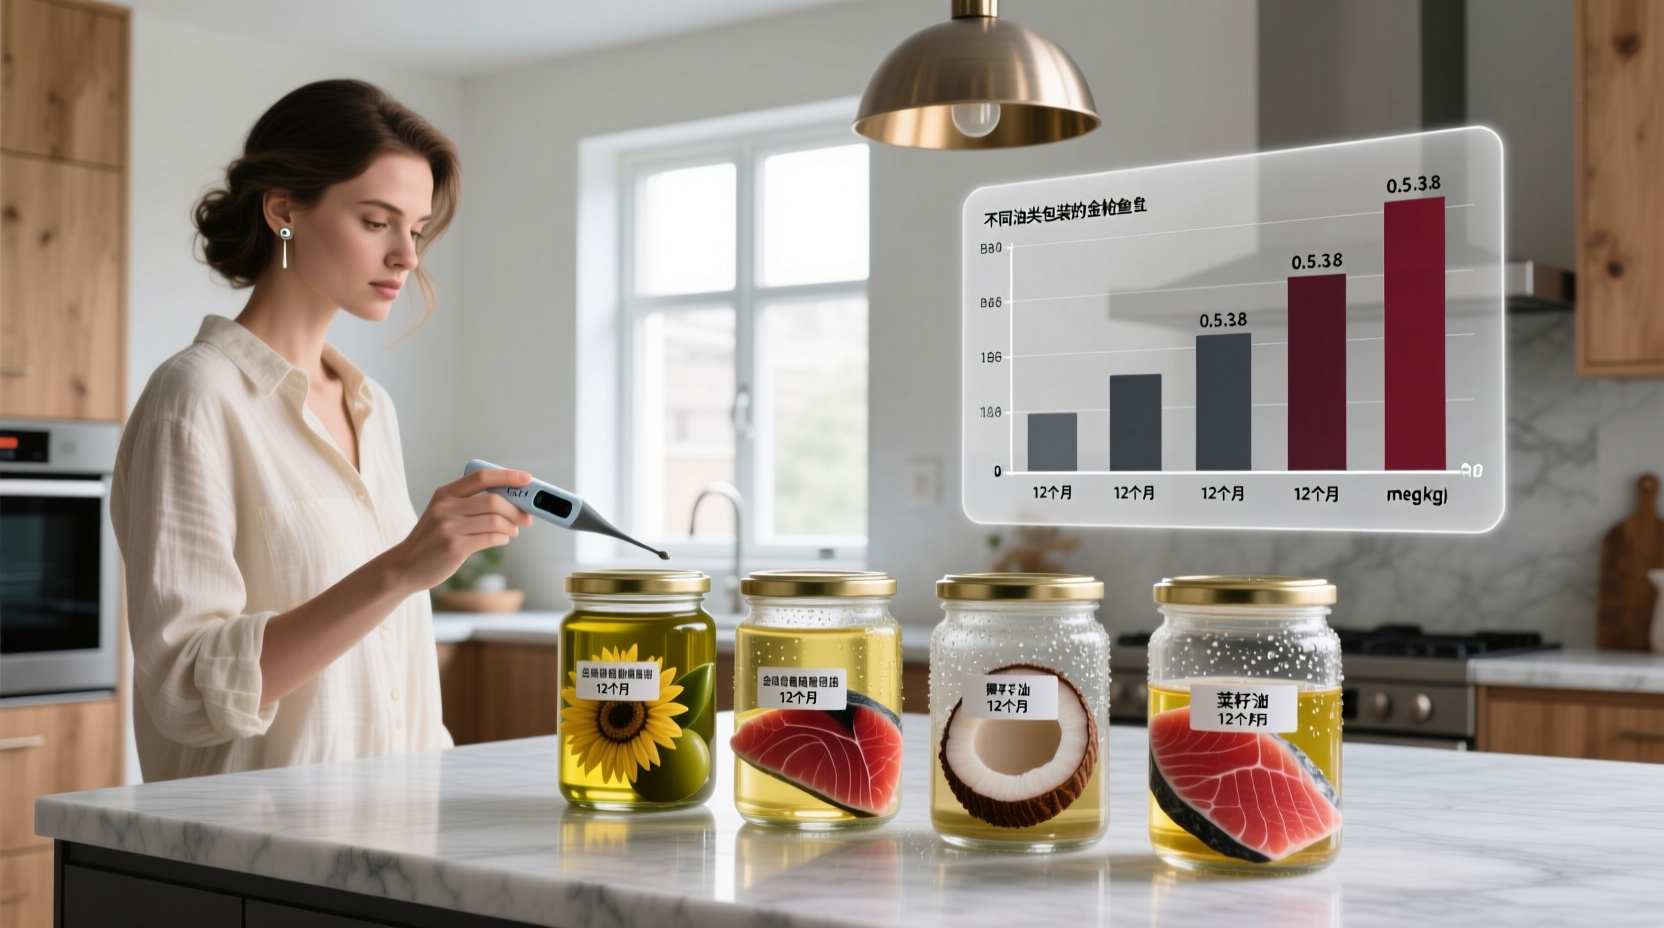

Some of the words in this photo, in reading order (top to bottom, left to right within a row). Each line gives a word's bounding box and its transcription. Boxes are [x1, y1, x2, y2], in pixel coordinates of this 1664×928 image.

[1386, 175, 1441, 194] 0.5.3.8
[1291, 252, 1343, 270] 0.5.38
[1199, 312, 1248, 328] 0.5.38
[994, 465, 1002, 477] 0
[1033, 485, 1072, 500] 12个月
[1113, 485, 1155, 500] 12个月
[1201, 485, 1245, 501] 12个月
[1294, 485, 1339, 502] 12个月
[596, 682, 630, 696] 12个月
[780, 691, 818, 705] 12个月
[986, 699, 1028, 713] 12个月
